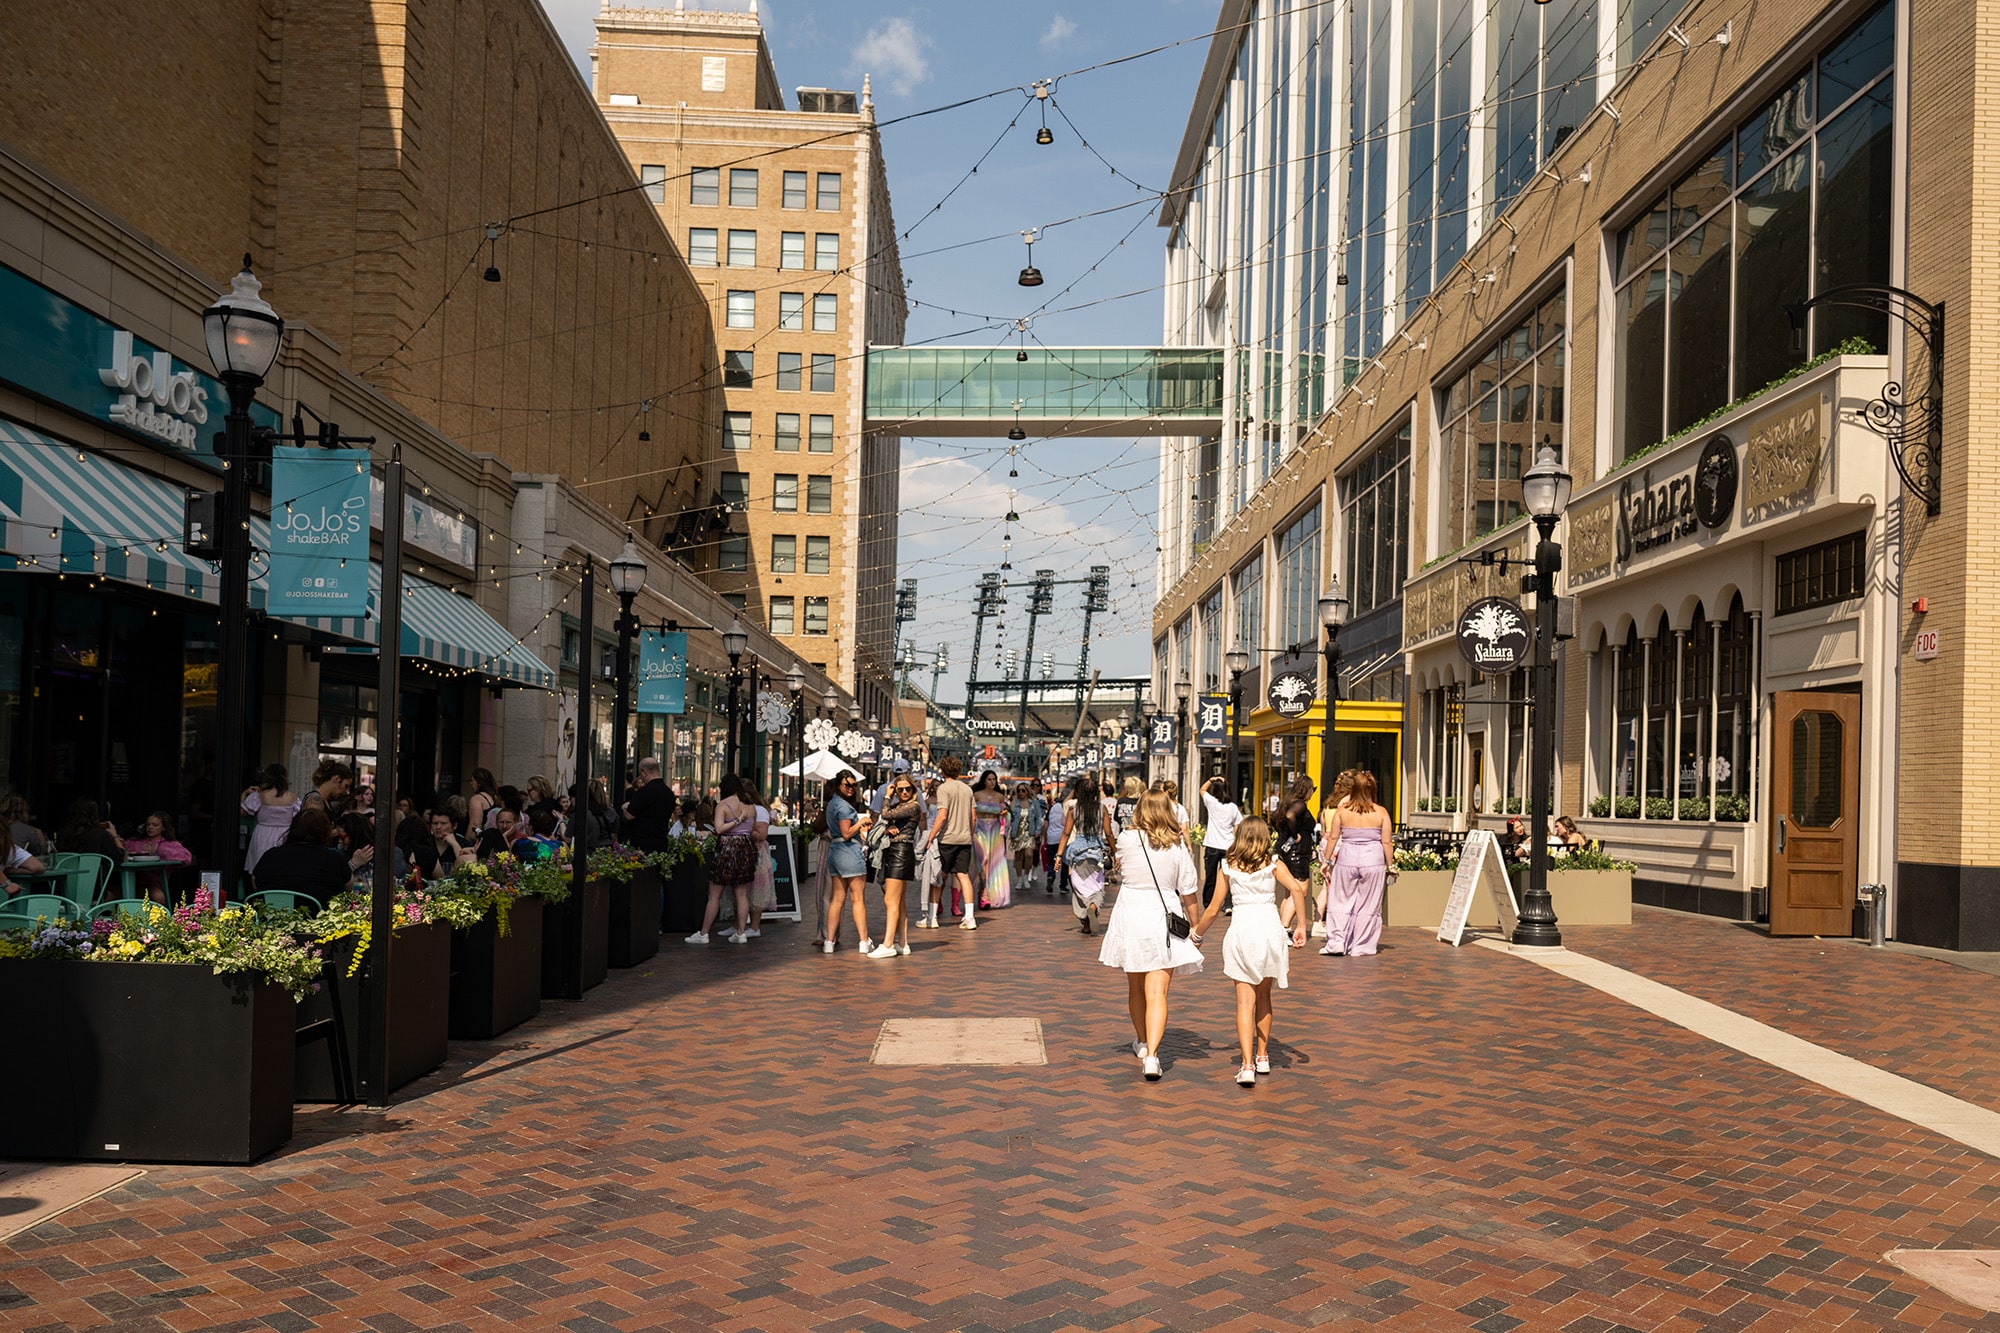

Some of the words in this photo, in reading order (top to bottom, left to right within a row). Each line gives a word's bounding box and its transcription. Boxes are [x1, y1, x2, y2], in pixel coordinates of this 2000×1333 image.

[1616, 469, 1694, 563] Sahara
[286, 530, 350, 545] shakeBAR
[285, 591, 349, 599] @JOJOSSHAKEBAR
[1917, 633, 1936, 652] FDC
[1475, 643, 1513, 662] Sahara
[1279, 700, 1304, 713] Sahara
